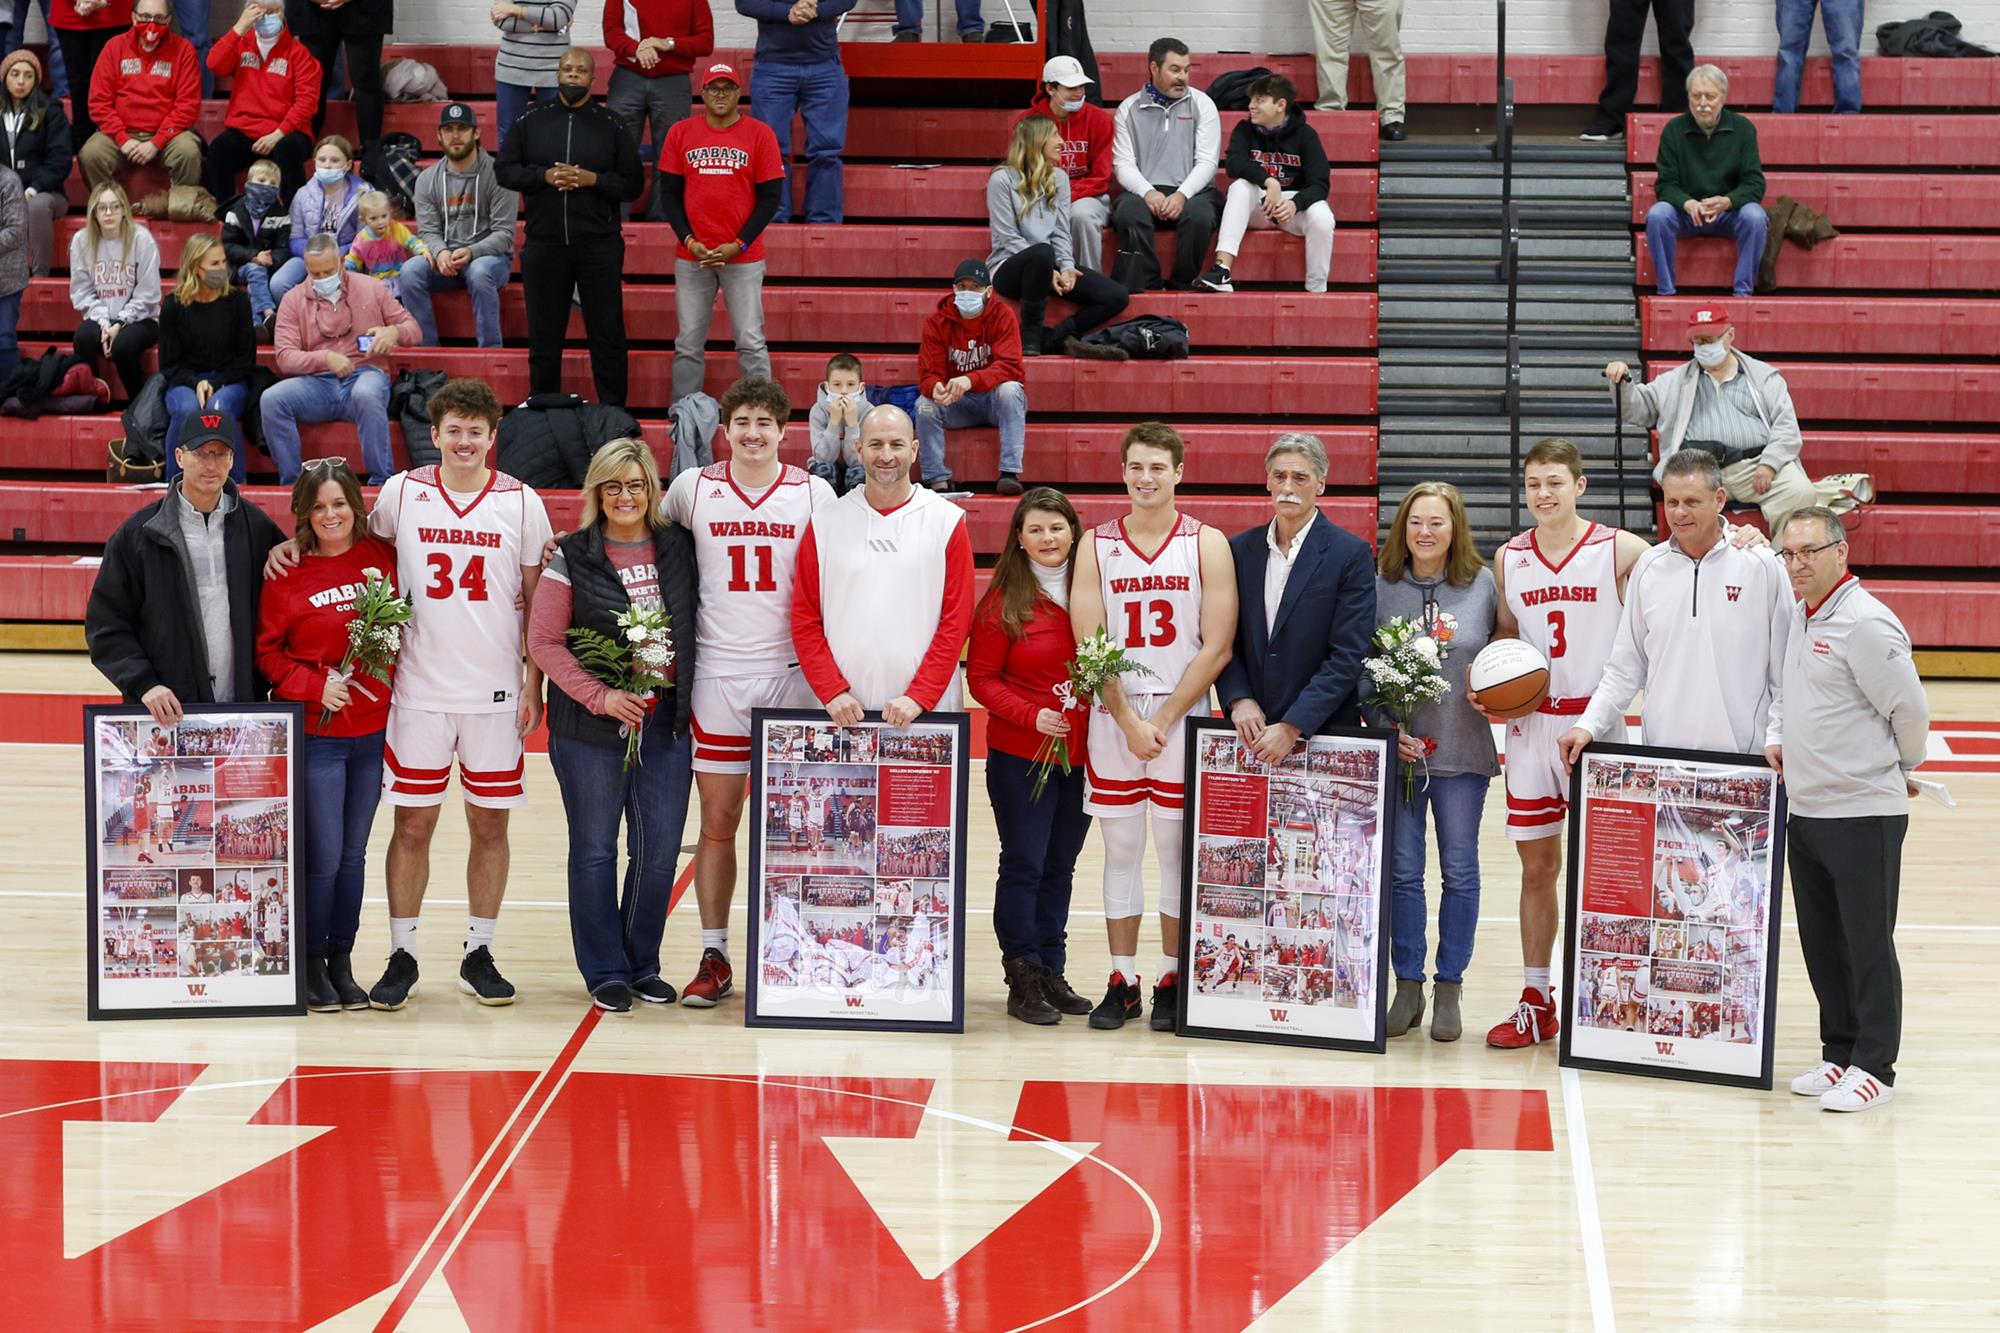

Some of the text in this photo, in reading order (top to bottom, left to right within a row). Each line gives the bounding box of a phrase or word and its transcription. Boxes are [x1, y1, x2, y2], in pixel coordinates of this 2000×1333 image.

[686, 147, 749, 167] WABASH
[693, 159, 740, 170] COLLEGE
[200, 415, 223, 429] W
[418, 527, 502, 549] WABASH
[709, 521, 795, 540] WABASH
[426, 552, 489, 601] 34
[727, 545, 777, 592] 11
[1110, 575, 1190, 594] WABASH
[1520, 586, 1598, 608] WABASH
[1124, 598, 1178, 648] 13
[1547, 610, 1567, 659] 3
